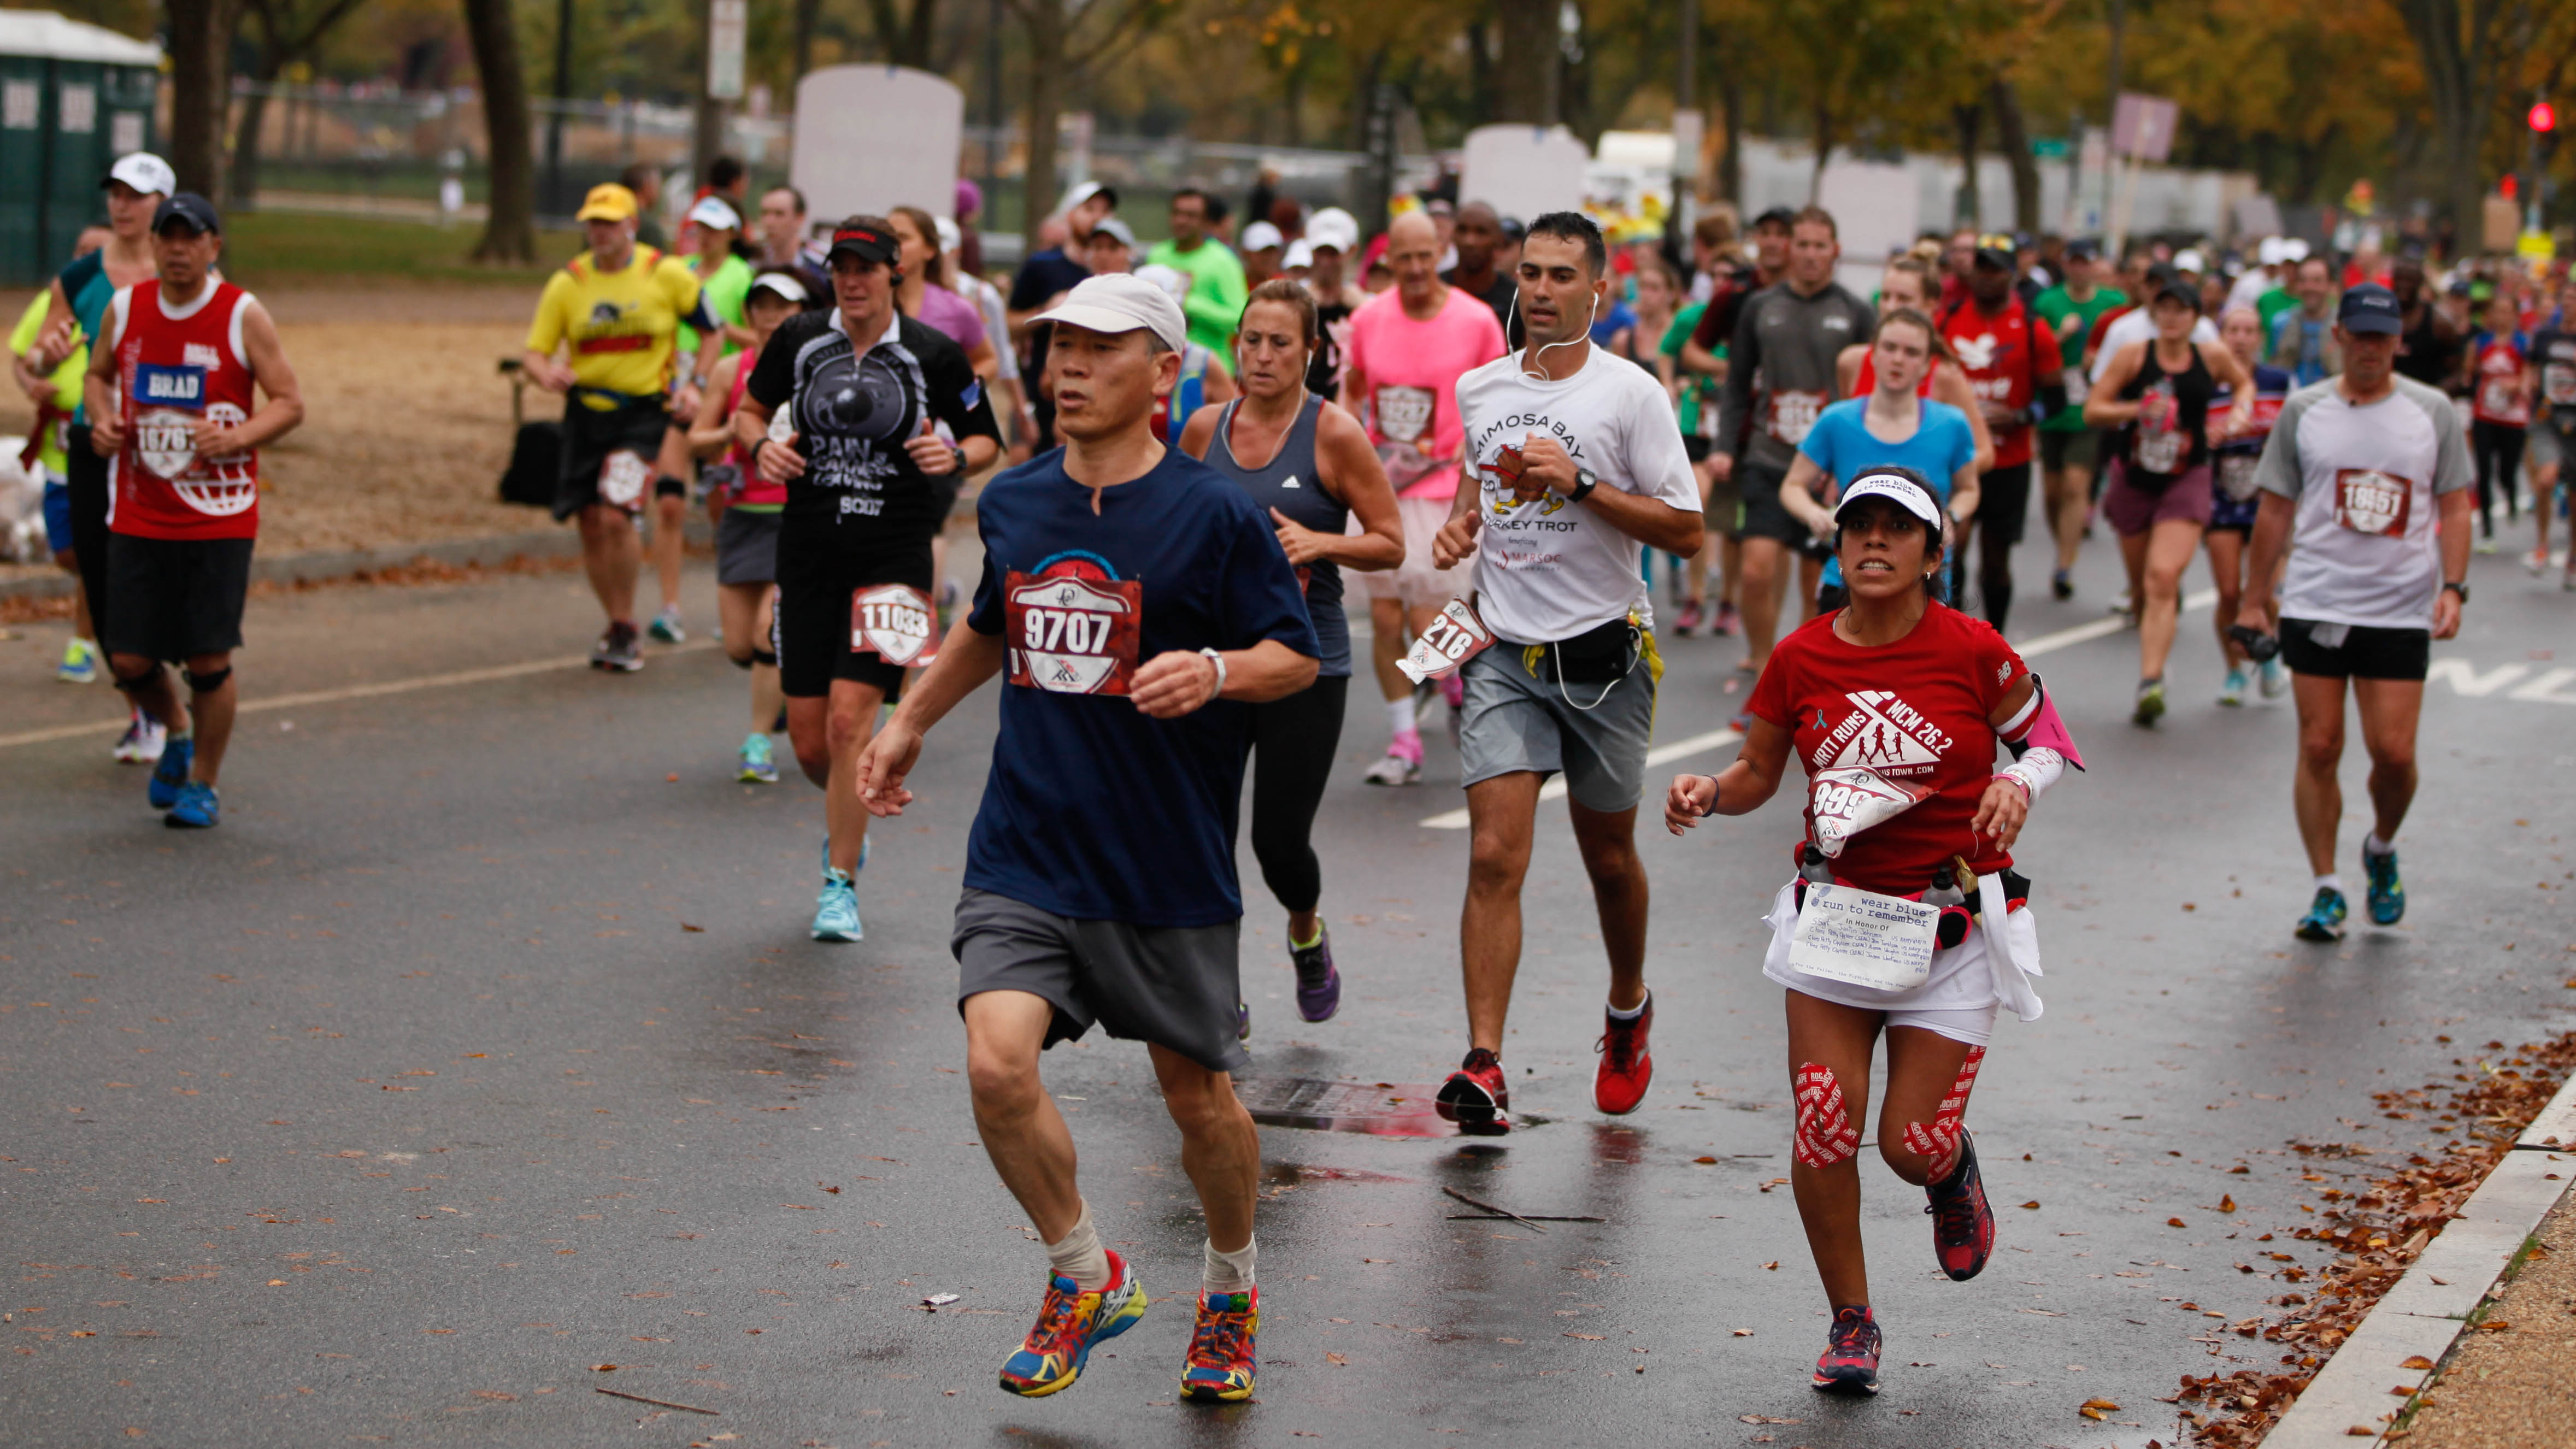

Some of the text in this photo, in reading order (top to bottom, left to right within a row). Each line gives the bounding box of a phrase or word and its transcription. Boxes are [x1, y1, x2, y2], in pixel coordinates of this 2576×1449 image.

[148, 373, 199, 399] BRAD
[1477, 413, 1585, 459] MIMOSA BAY
[1484, 515, 1578, 532] TURKEY TROT
[1512, 551, 1561, 564] MARSOC
[1025, 608, 1112, 655] 9707
[1422, 614, 1474, 659] 216
[1812, 710, 1867, 769] MRTT RUNS
[1885, 699, 1953, 755] MCM 26.2
[1892, 768, 1913, 776] TOWN
[1915, 765, 1934, 775] .COM
[1813, 782, 1883, 819] 999
[1822, 900, 1928, 927] run to remember
[1861, 898, 1891, 910] wear
[1855, 920, 1878, 929] Honor
